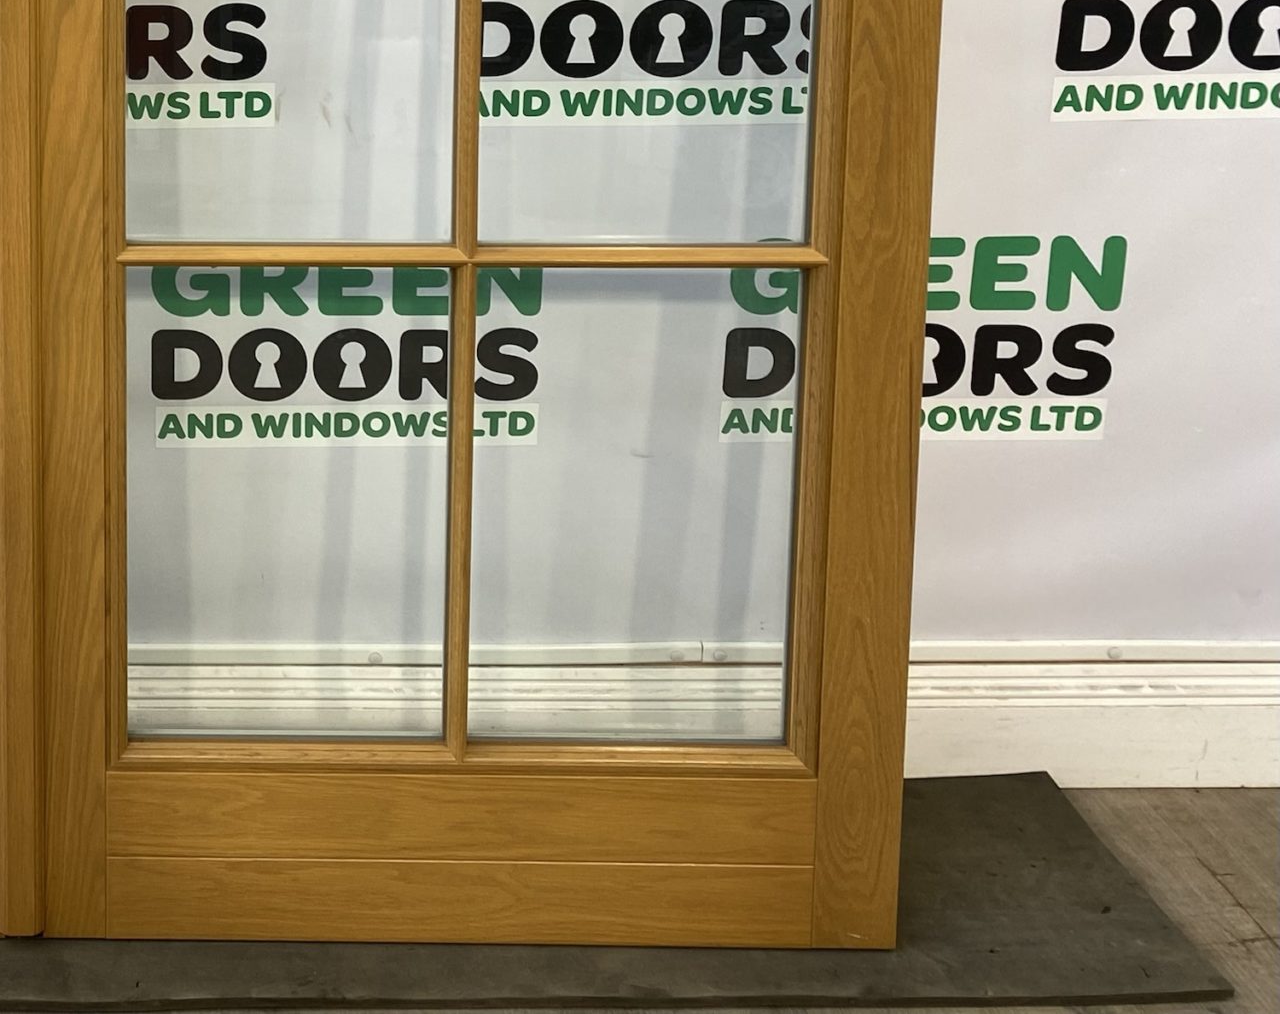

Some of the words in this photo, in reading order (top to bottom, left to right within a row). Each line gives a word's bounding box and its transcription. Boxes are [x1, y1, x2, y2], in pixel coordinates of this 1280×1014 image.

[200, 92, 272, 120] LTD
[560, 87, 773, 116] WINDOWS
[1053, 84, 1144, 113] AND
[151, 266, 544, 318] GREEN
[151, 327, 539, 402] DOORS
[158, 412, 243, 440] AND
[251, 410, 448, 439] WINDOWS
[1029, 404, 1103, 432] LTD
